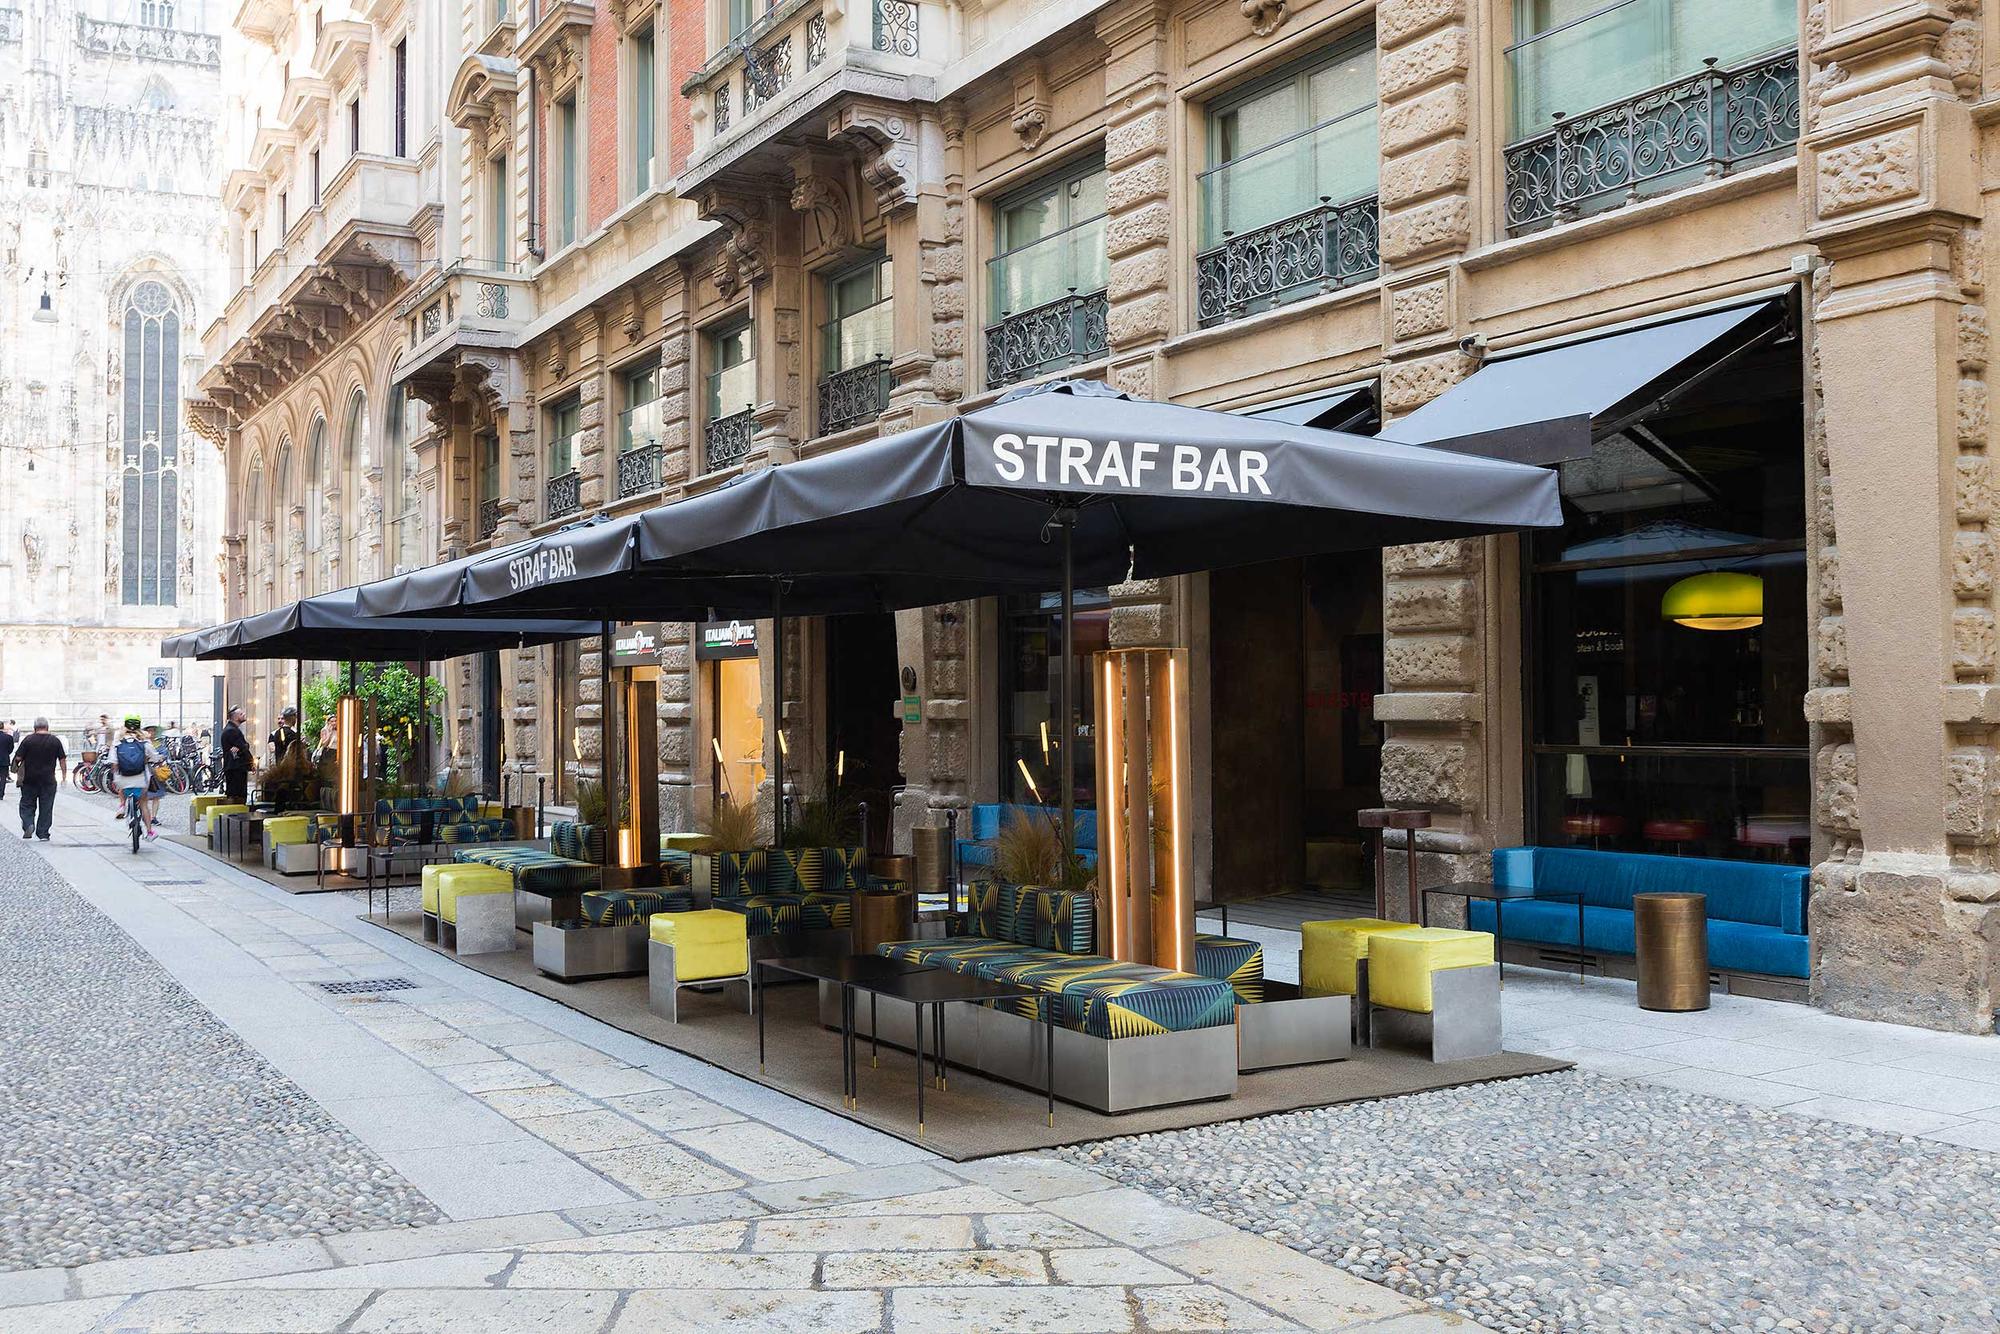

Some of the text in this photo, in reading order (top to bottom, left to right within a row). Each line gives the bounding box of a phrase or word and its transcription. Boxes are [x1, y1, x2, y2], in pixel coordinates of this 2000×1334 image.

[992, 433, 1272, 495] STRAF BAR
[509, 545, 577, 590] STRAF BAR
